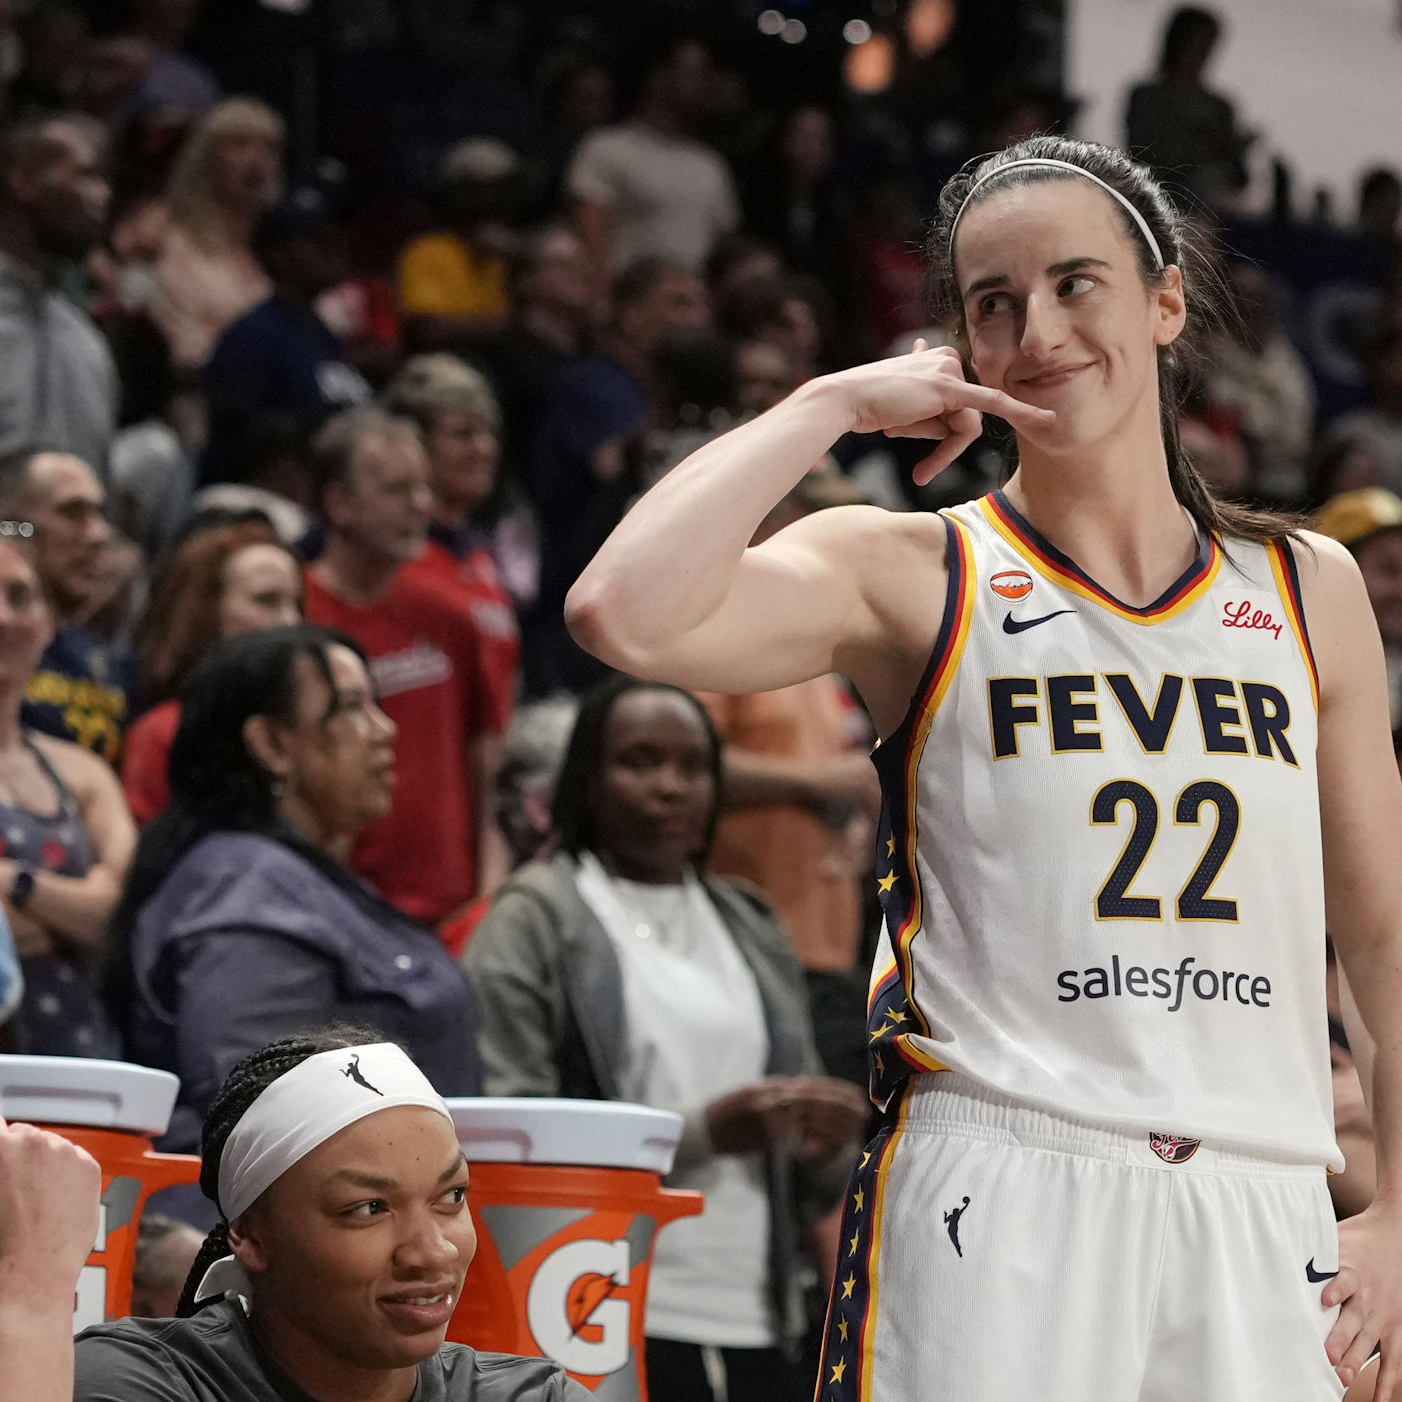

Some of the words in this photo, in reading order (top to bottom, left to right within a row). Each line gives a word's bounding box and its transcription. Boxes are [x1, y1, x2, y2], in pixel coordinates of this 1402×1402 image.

[1222, 600, 1283, 640] Lilly
[987, 672, 1301, 770] FEVER
[1089, 777, 1242, 924] 22
[1057, 955, 1271, 1012] salesforce
[526, 1237, 631, 1377] G
